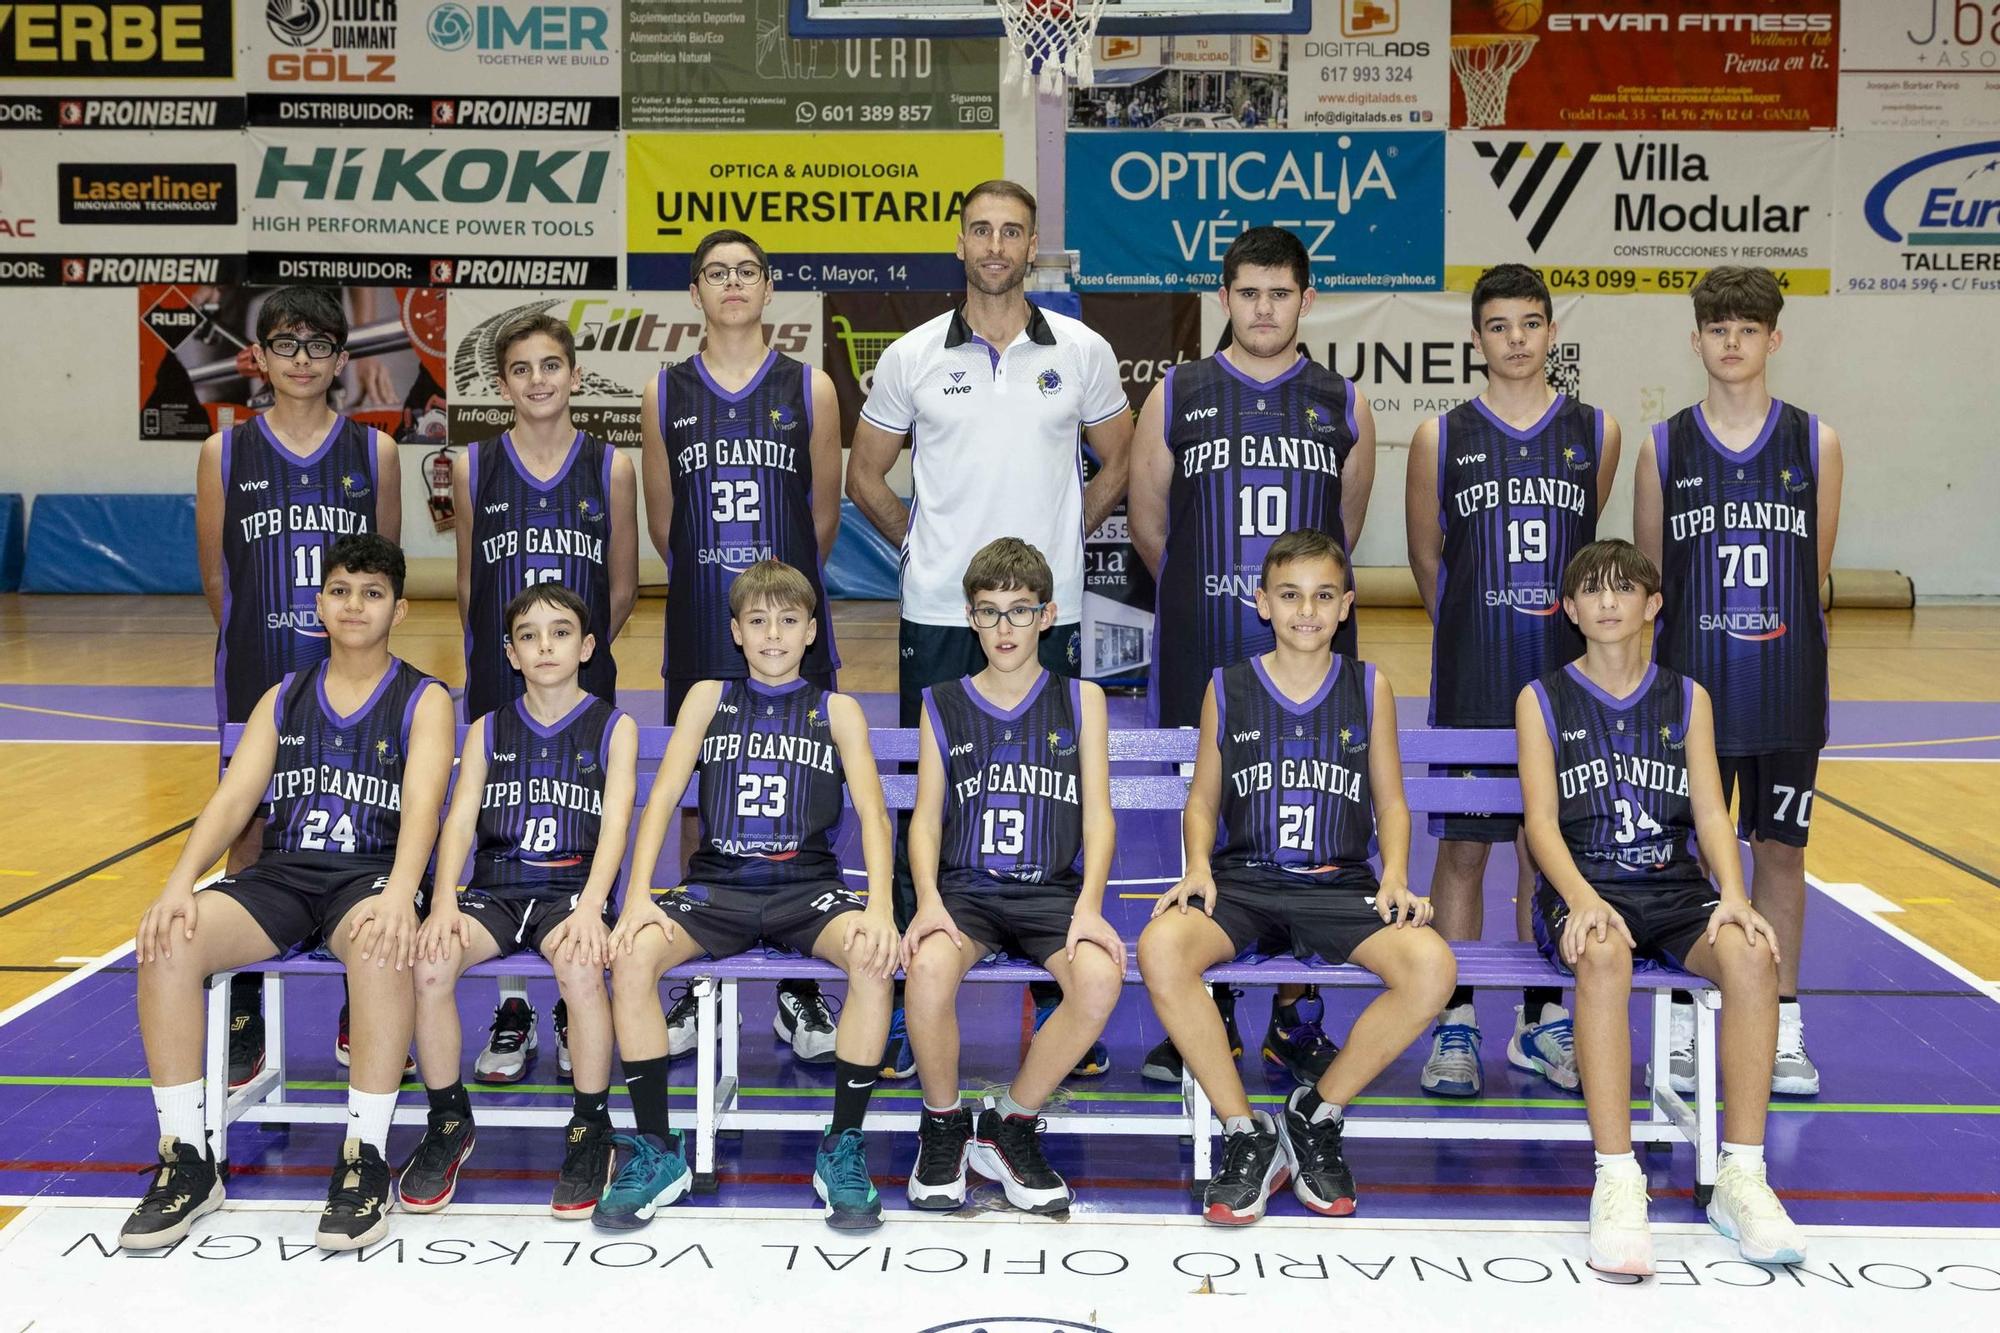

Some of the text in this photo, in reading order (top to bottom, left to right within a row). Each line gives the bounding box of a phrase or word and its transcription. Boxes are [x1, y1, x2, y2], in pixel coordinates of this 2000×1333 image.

[629, 12, 746, 24] Suplementación Deportiva
[1547, 13, 1832, 32] ETVAN FITNESS
[332, 26, 397, 49] DIAMANT
[477, 6, 609, 51] IMER
[629, 32, 724, 43] Alimentación Bio/Eco
[1196, 39, 1208, 49] TU
[1750, 32, 1798, 46] Wellness
[629, 52, 711, 63] Cosmética Natural
[845, 38, 932, 79] VERD
[1175, 51, 1229, 62] PUBLICIDAD
[1304, 42, 1430, 57] DIGITALADS
[267, 48, 396, 82] GÖLZ
[477, 54, 610, 66] TOGETHER WE BUILD
[1724, 52, 1780, 73] Piensa
[1784, 55, 1804, 69] en
[1321, 66, 1413, 82] 617 993 324
[1318, 93, 1418, 105] www.digitalads.es
[84, 101, 217, 126] PROINBENI
[279, 100, 591, 126] DISTRIBUIDOR: PROINBENI
[821, 105, 932, 122] 601 389 857
[1304, 110, 1403, 124] info@digitalads.es
[710, 163, 919, 178] OPTICA & AUDIOLOGIA
[1614, 142, 1709, 182] Villa
[72, 175, 222, 200] Laserliner
[73, 201, 218, 211] INNOVATION TECHNOLOGY
[1613, 193, 1810, 233] Modular
[1918, 187, 2000, 227] Eur
[252, 216, 595, 237] HIGH PERFORMANCE POWER TOOLS
[1171, 209, 1336, 262] VÉZ
[1613, 245, 1808, 258] CONSTRUCCIONES Y REFORMAS
[87, 258, 220, 283] PROINBENI
[278, 260, 589, 286] DISTRIBUIDOR: PROINBENI
[799, 266, 906, 285] C. Mayor, 14
[1074, 273, 1104, 286] Paseo
[1105, 273, 1163, 287] Germanías,
[1165, 274, 1178, 285] 60
[1185, 274, 1217, 285] 46702
[1323, 274, 1436, 288] opticavelez@yahoo.es
[1550, 270, 1590, 288] 043
[1595, 270, 1636, 288] 099
[1657, 270, 1697, 288] 657
[1849, 278, 1875, 290] 962
[1880, 278, 1907, 290] 804
[1912, 278, 1938, 290] 596
[151, 314, 197, 326] RUBI
[943, 385, 972, 395] vive
[673, 415, 698, 429] vive
[1185, 406, 1218, 422] vive
[1183, 435, 1338, 478] UPB GANDIA
[1456, 452, 1487, 466] vive
[239, 480, 269, 492] vive
[1675, 476, 1704, 489] vive
[710, 480, 760, 522] 32
[1454, 477, 1586, 518] UPB GANDIA
[485, 502, 509, 514] vive
[1239, 486, 1288, 536] 10
[240, 504, 368, 543] UPB GANDIA
[1670, 501, 1809, 541] UPB GANDIA
[482, 527, 603, 565] UPB GANDIA
[1507, 519, 1547, 563] 19
[698, 547, 772, 564] SANDEMI
[1718, 544, 1769, 588] 70
[1087, 576, 1127, 585] ESTATE
[1699, 613, 1779, 631] SANDEMI
[717, 701, 738, 714] ive
[279, 734, 305, 746] vive
[1233, 729, 1261, 743] vive
[493, 752, 517, 762] vive
[702, 732, 834, 774] UPB GANDIA
[949, 742, 974, 757] vive
[273, 764, 401, 812] UPB GANDIA
[987, 763, 1079, 805] GANDIA
[1232, 759, 1362, 803] UPB GANDIA
[1560, 758, 1609, 799] UPB
[528, 777, 602, 816] GANDIA
[737, 774, 787, 817] 23
[300, 809, 356, 853] 24
[519, 816, 558, 853] 18
[981, 808, 1025, 855] 13
[1279, 805, 1315, 851] 21
[761, 1244, 1130, 1276] OFICIAL
